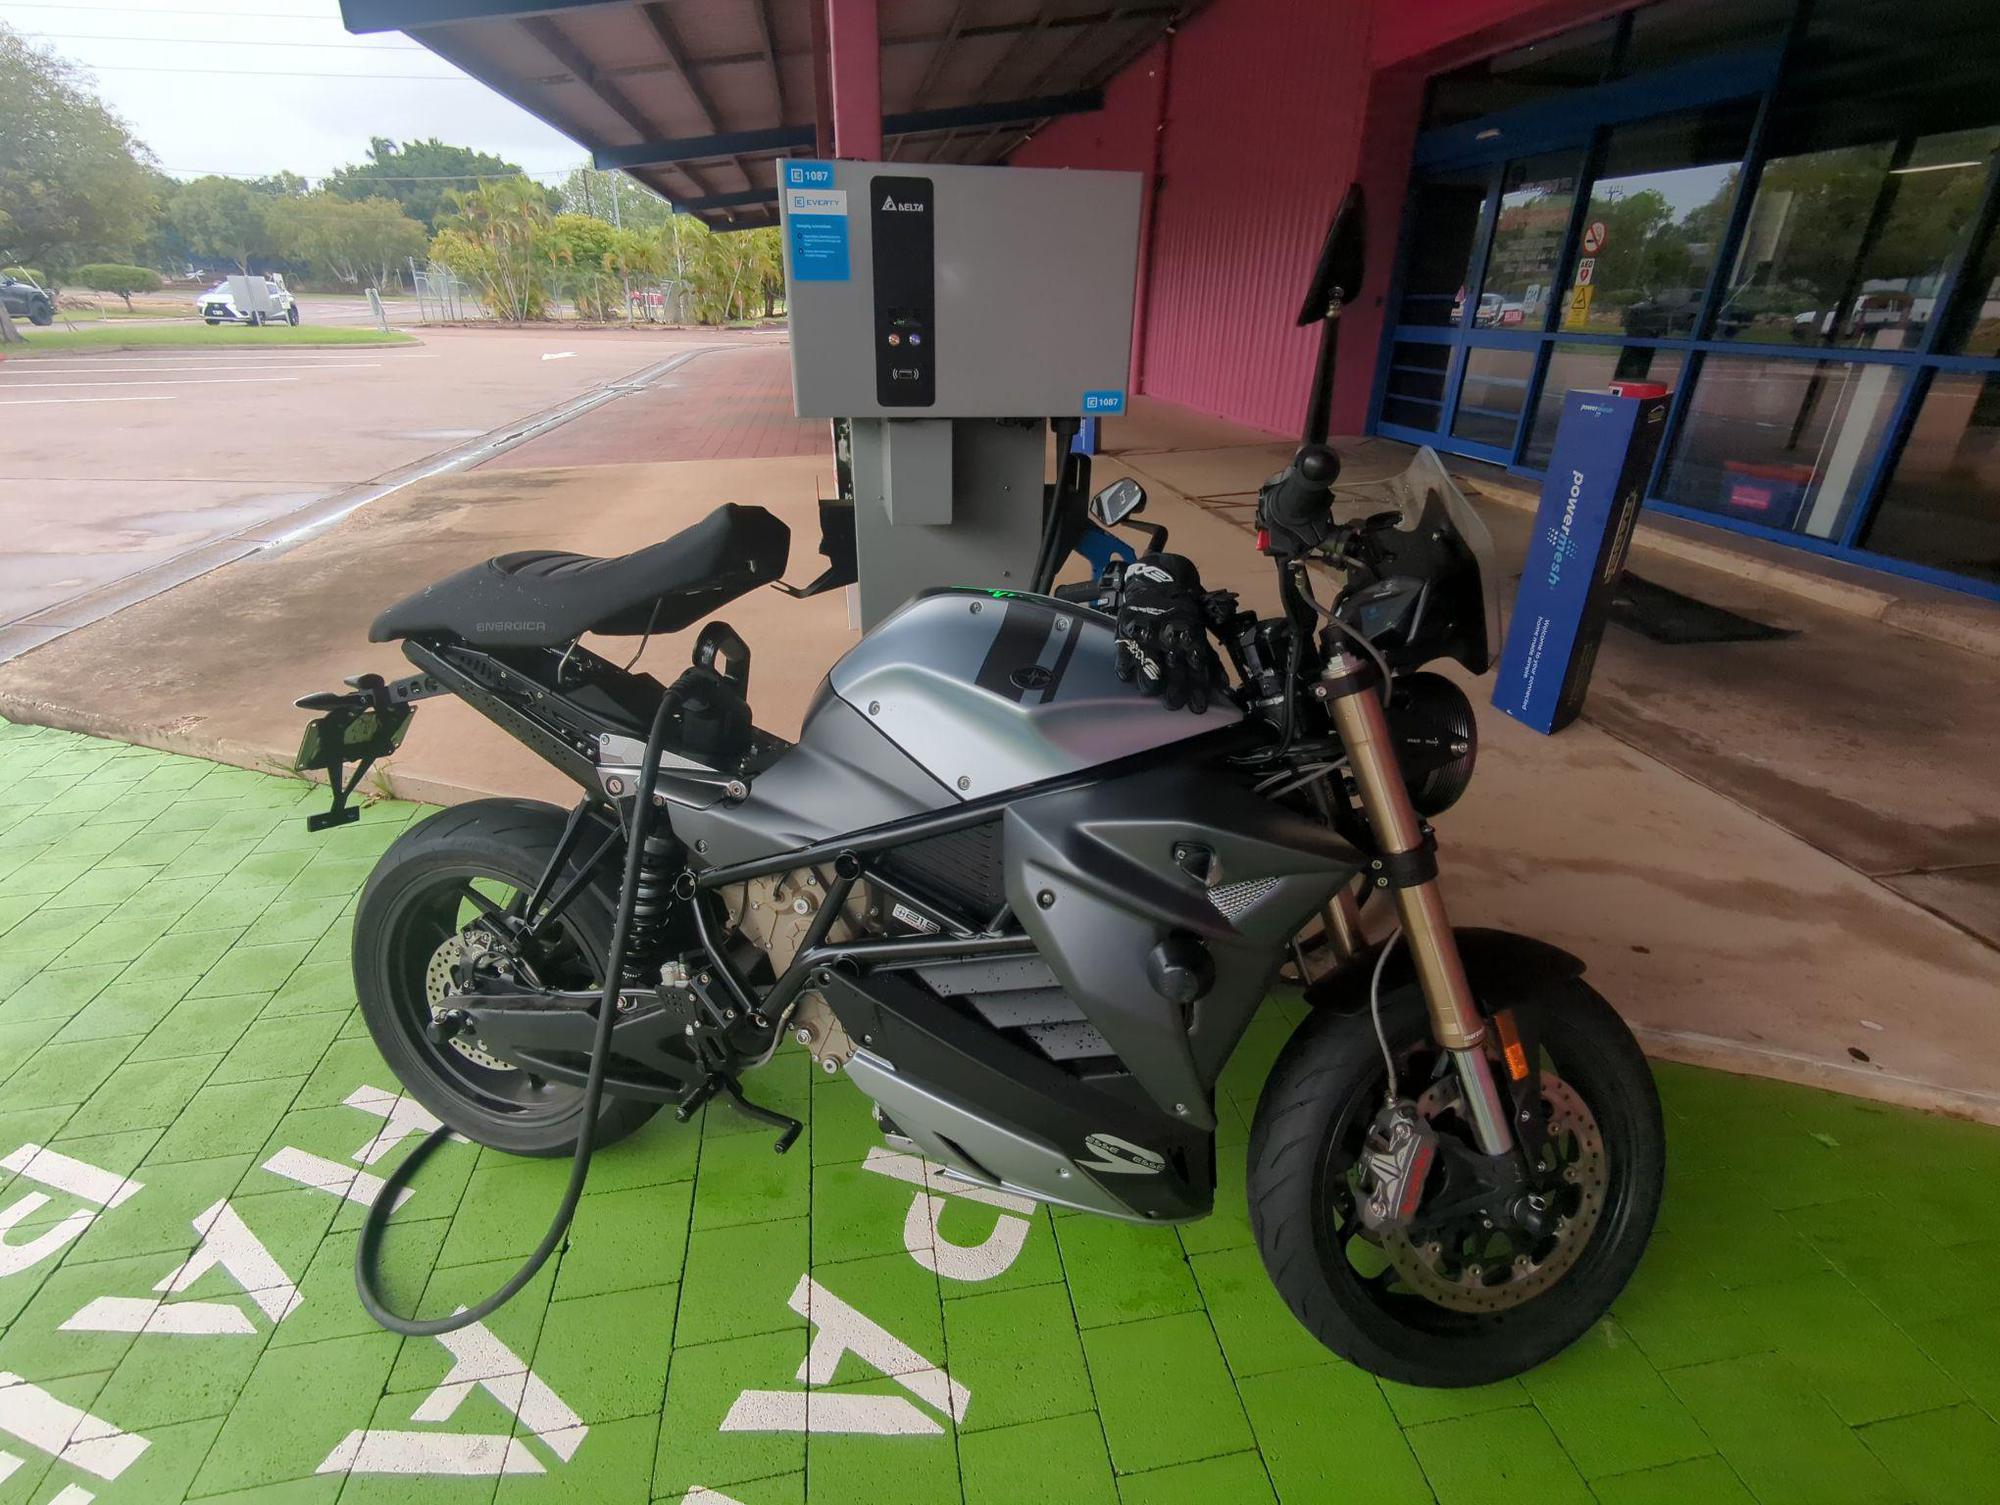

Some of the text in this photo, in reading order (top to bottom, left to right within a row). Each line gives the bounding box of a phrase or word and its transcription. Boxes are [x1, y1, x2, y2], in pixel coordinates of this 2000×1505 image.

[805, 171, 828, 182] 1087
[806, 199, 840, 207] EVERTY
[898, 203, 924, 212] DELTA
[1098, 398, 1119, 407] 1087
[1548, 469, 1584, 588] powermesh
[476, 620, 546, 632] ENERGICA
[1538, 619, 1551, 651] Welcome
[1523, 616, 1543, 679] home made simple
[1531, 660, 1539, 676] your
[1521, 675, 1534, 711] connected
